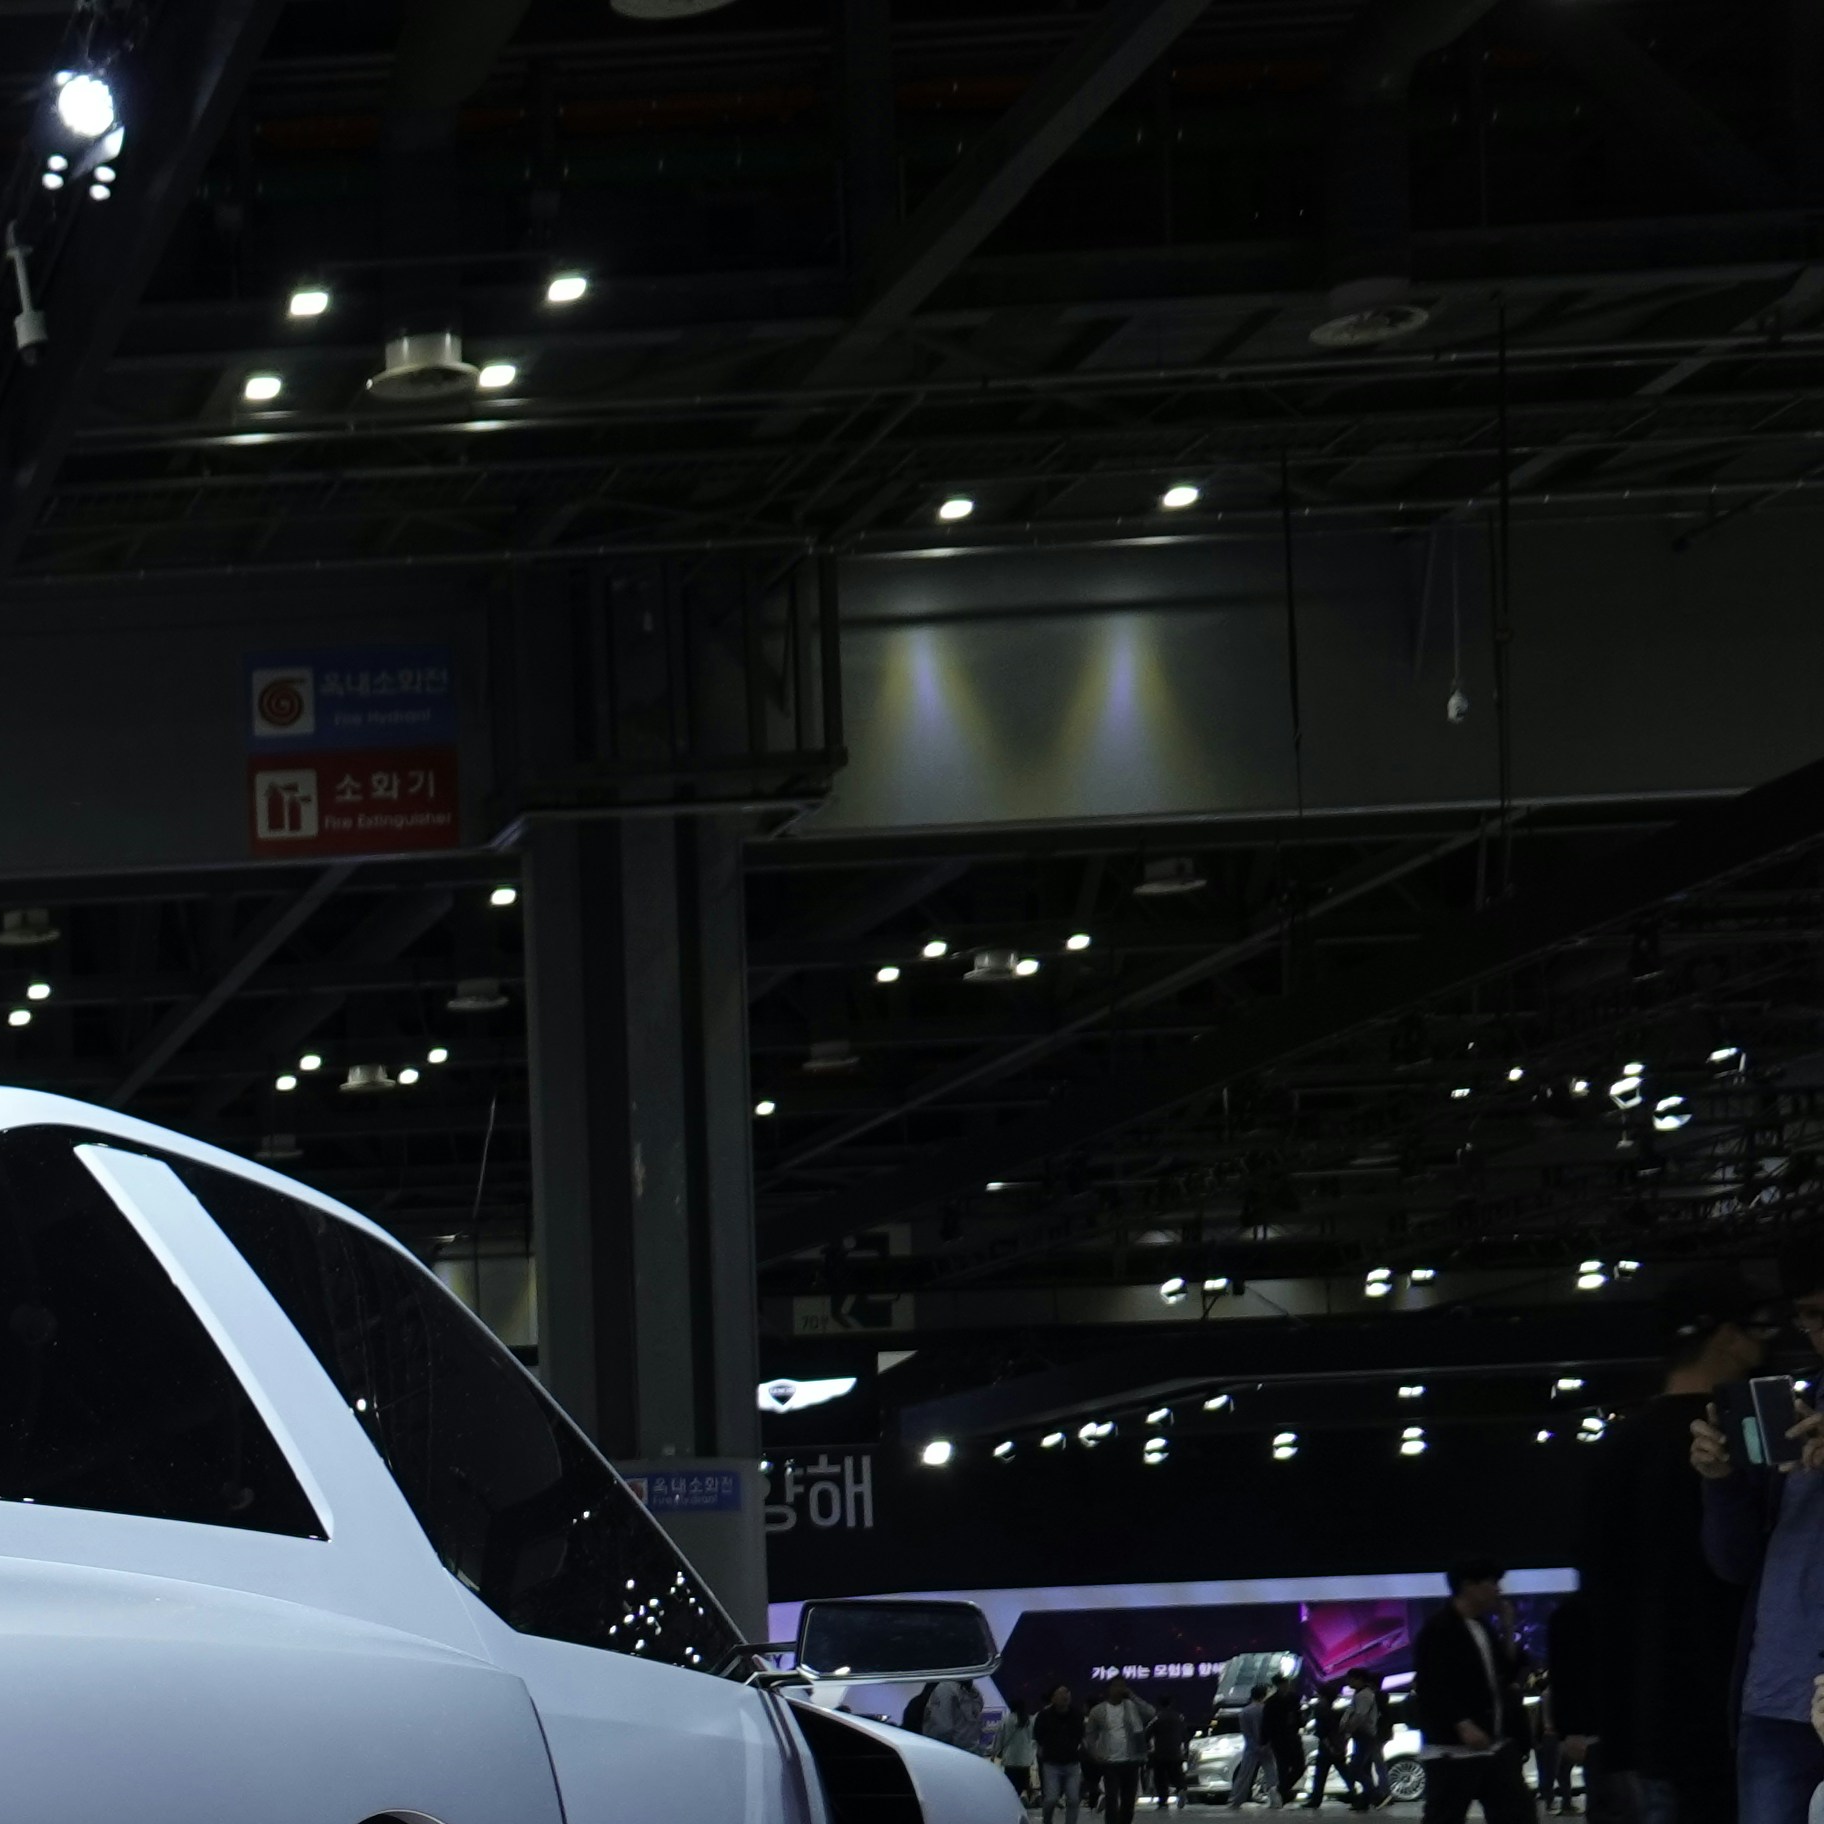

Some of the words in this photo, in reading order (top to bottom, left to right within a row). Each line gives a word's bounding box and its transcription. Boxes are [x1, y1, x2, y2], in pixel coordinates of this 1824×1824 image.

[320, 667, 448, 697] 옥내소화전
[335, 769, 435, 802] 소화기
[324, 815, 353, 831] Fire
[358, 811, 451, 831] Extinguisher
[653, 1476, 733, 1494] 옥내소화전
